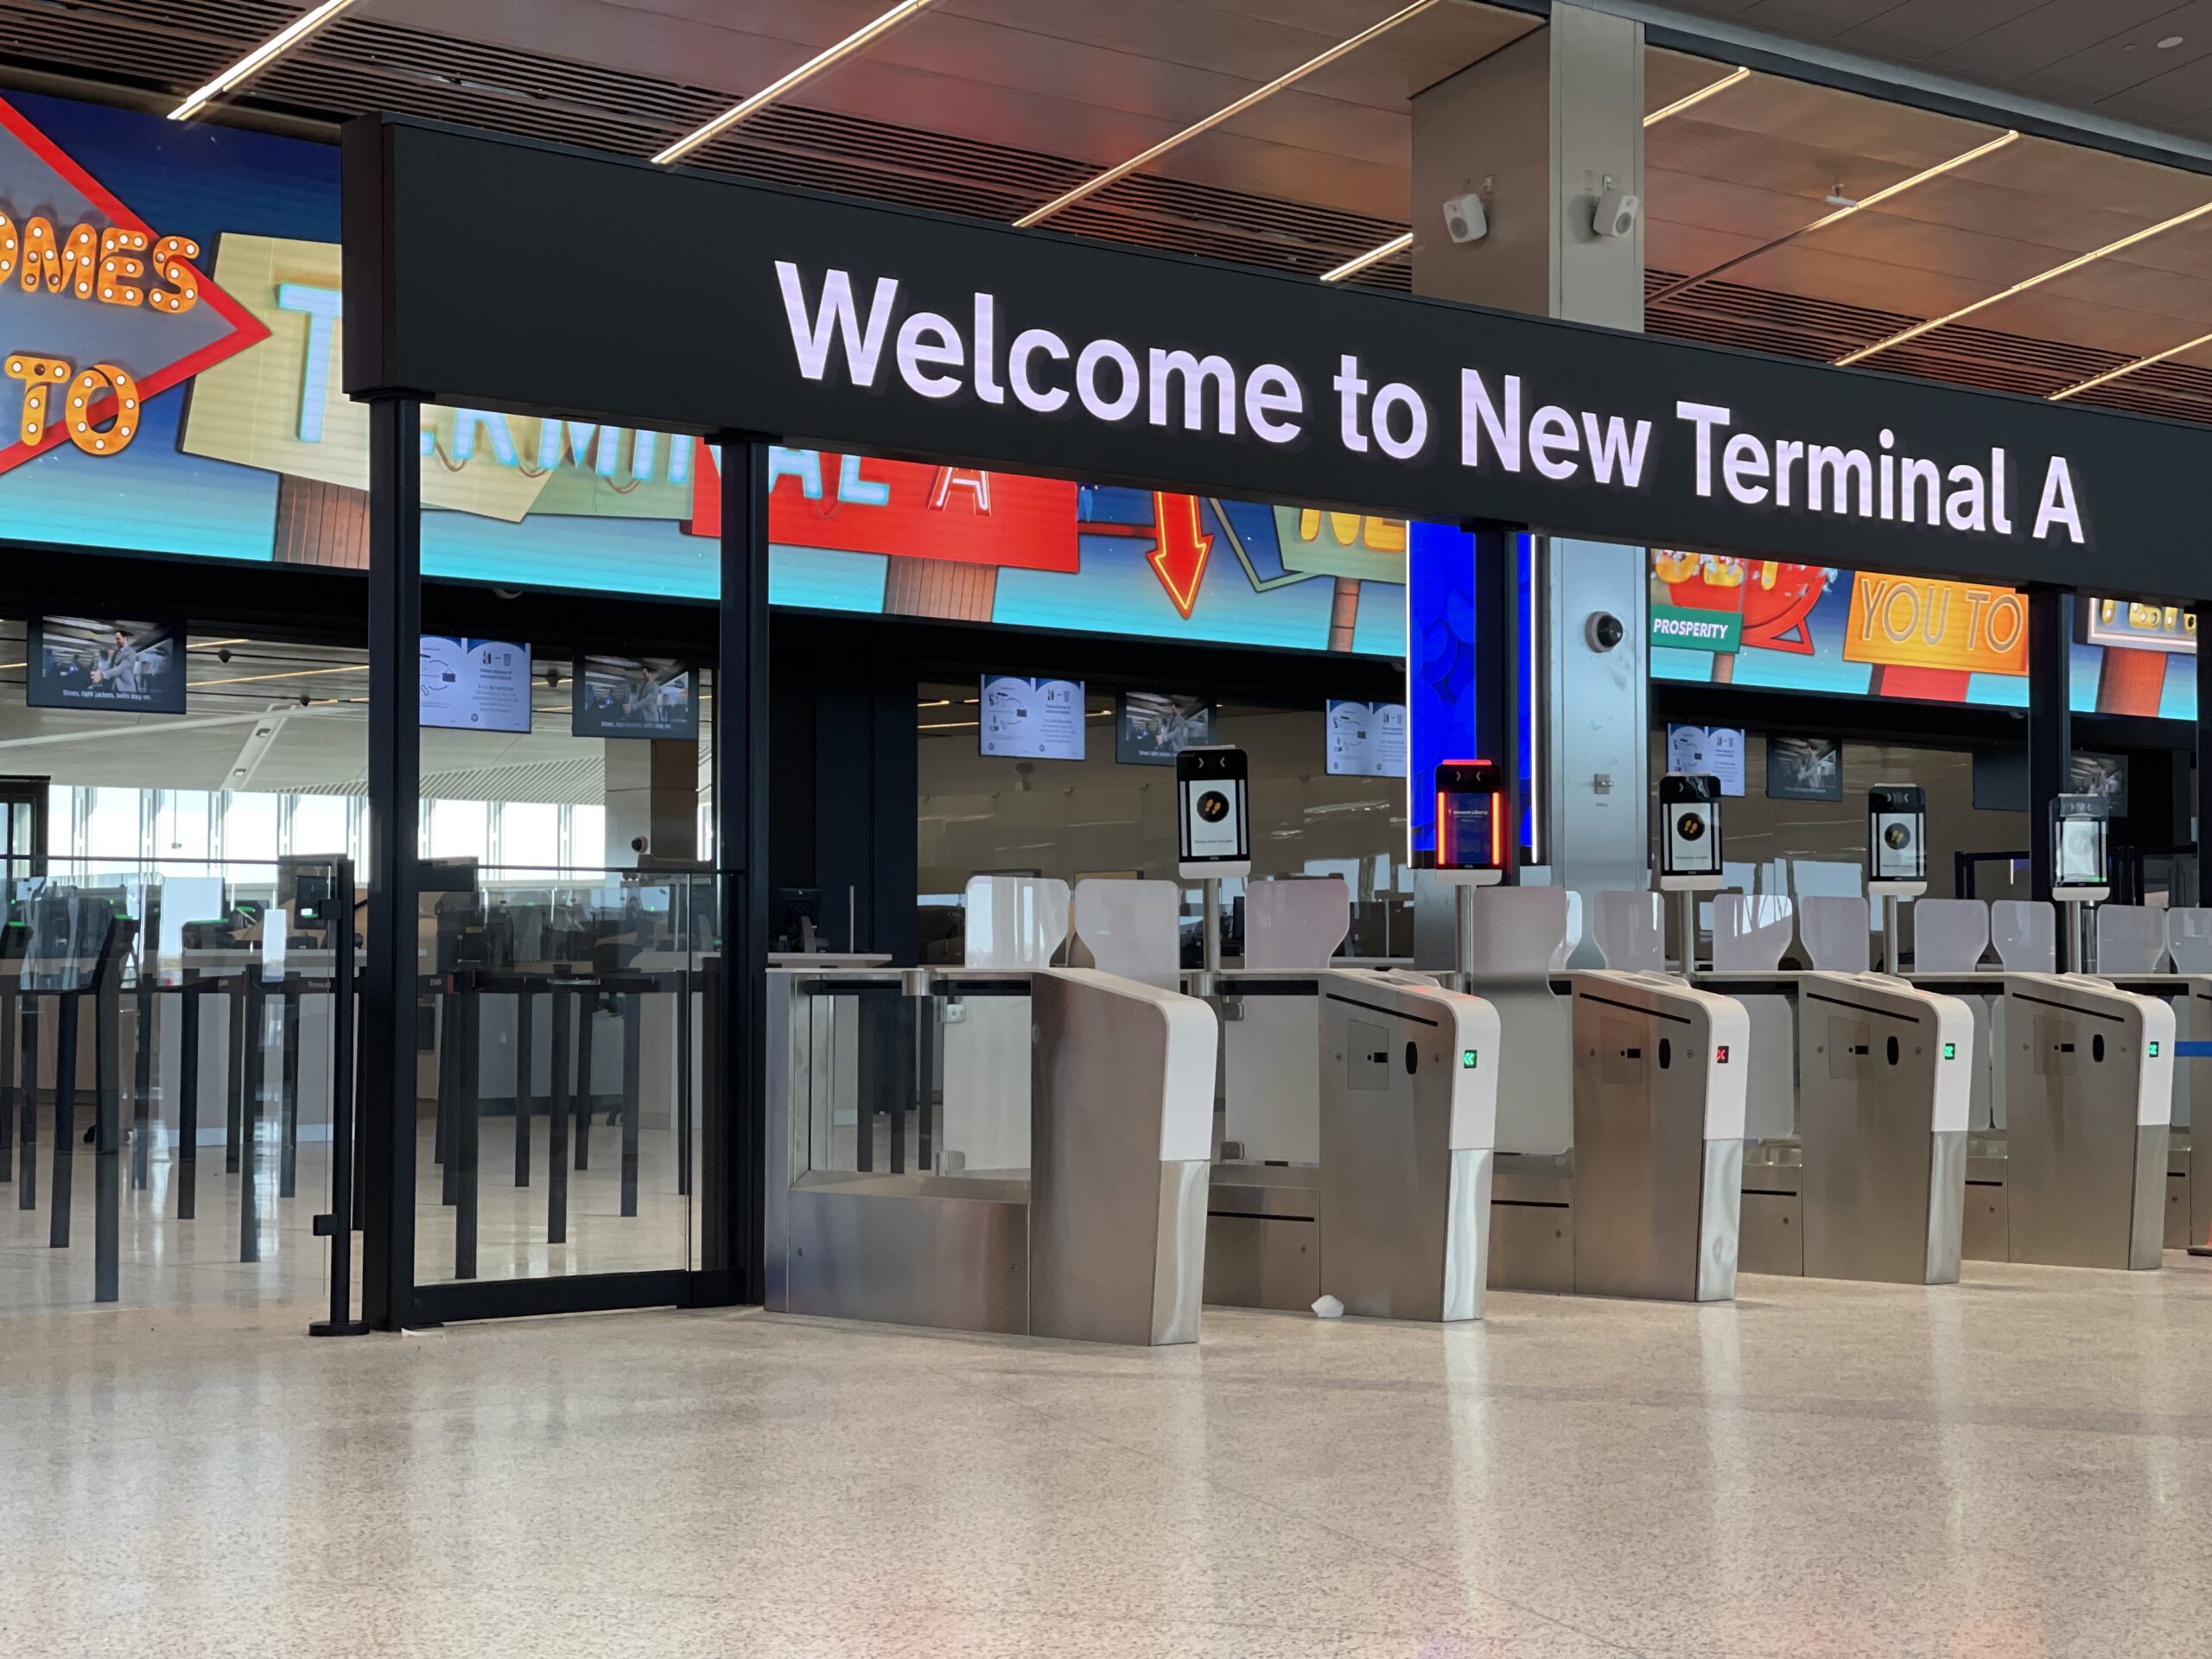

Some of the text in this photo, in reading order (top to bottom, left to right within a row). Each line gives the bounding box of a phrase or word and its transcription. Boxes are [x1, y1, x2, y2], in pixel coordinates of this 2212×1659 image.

[0, 211, 200, 313] MES
[4, 355, 139, 455] TO
[774, 260, 2085, 543] Welcome to New Terminal A
[1653, 618, 1728, 639] PROSPERITY
[1860, 578, 1951, 646] YOU
[1966, 589, 2023, 653] TO
